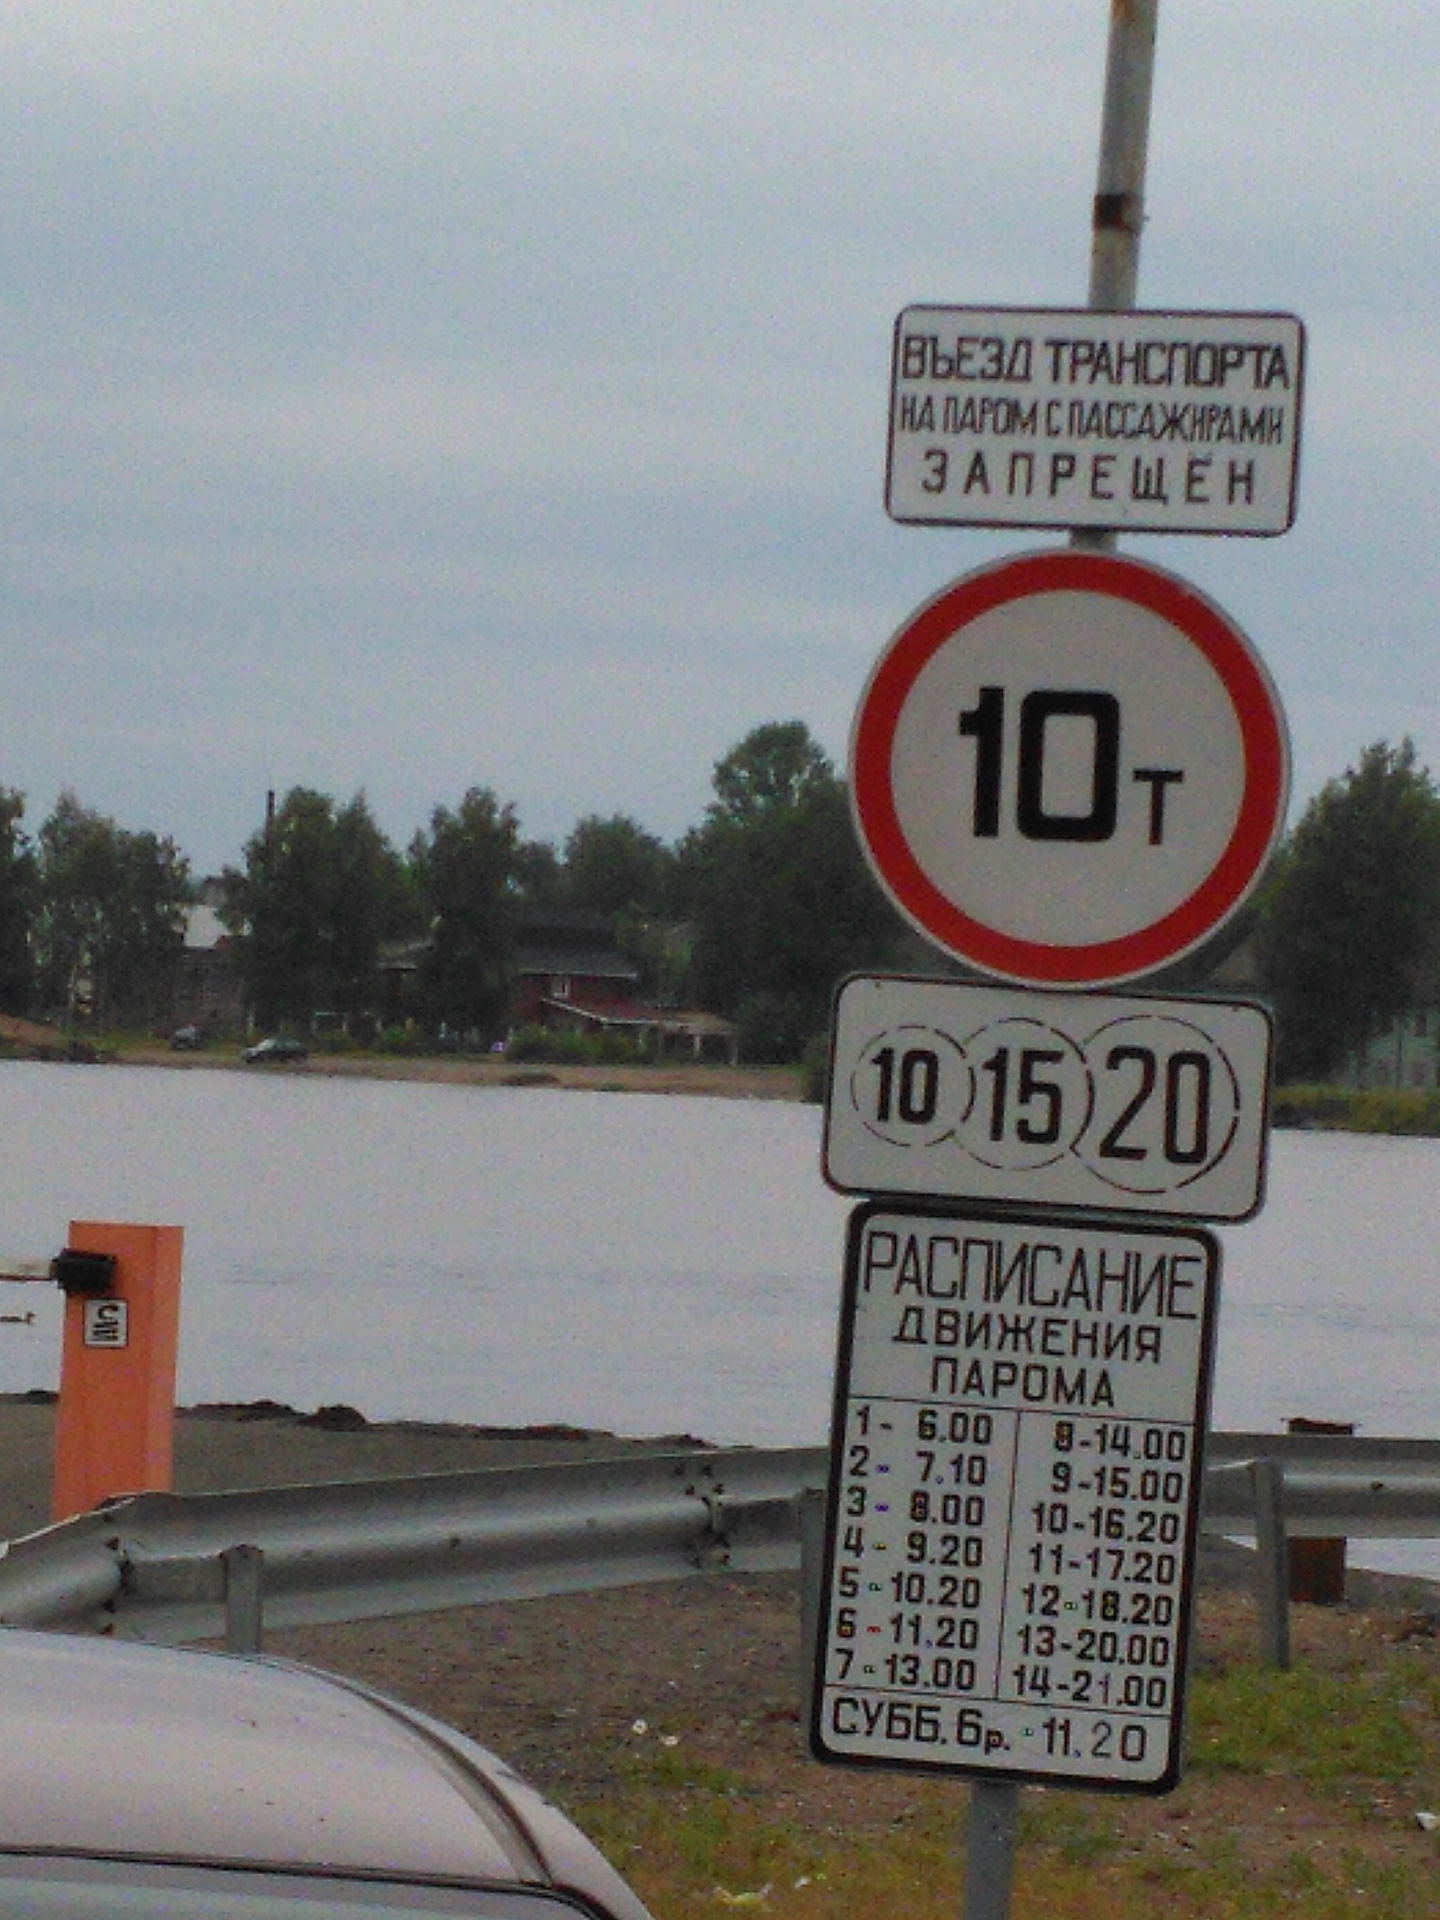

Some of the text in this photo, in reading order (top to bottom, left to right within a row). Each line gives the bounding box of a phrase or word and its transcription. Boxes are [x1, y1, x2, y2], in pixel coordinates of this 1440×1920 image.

[902, 335, 1290, 390] ВЪЕЗД ТРАНСПОРТА
[902, 397, 935, 432] НА
[944, 397, 1037, 436] ПАРОМ
[1046, 401, 1061, 437] С
[922, 449, 1255, 506] ЗАПРЕЩЕН
[872, 1045, 1211, 1163] 10 15 20
[864, 1231, 1202, 1320] РАСПИСАНИЕ
[892, 1306, 1162, 1363] ДВИЖЕНИЯ
[931, 1356, 1115, 1407] ПАРОМА
